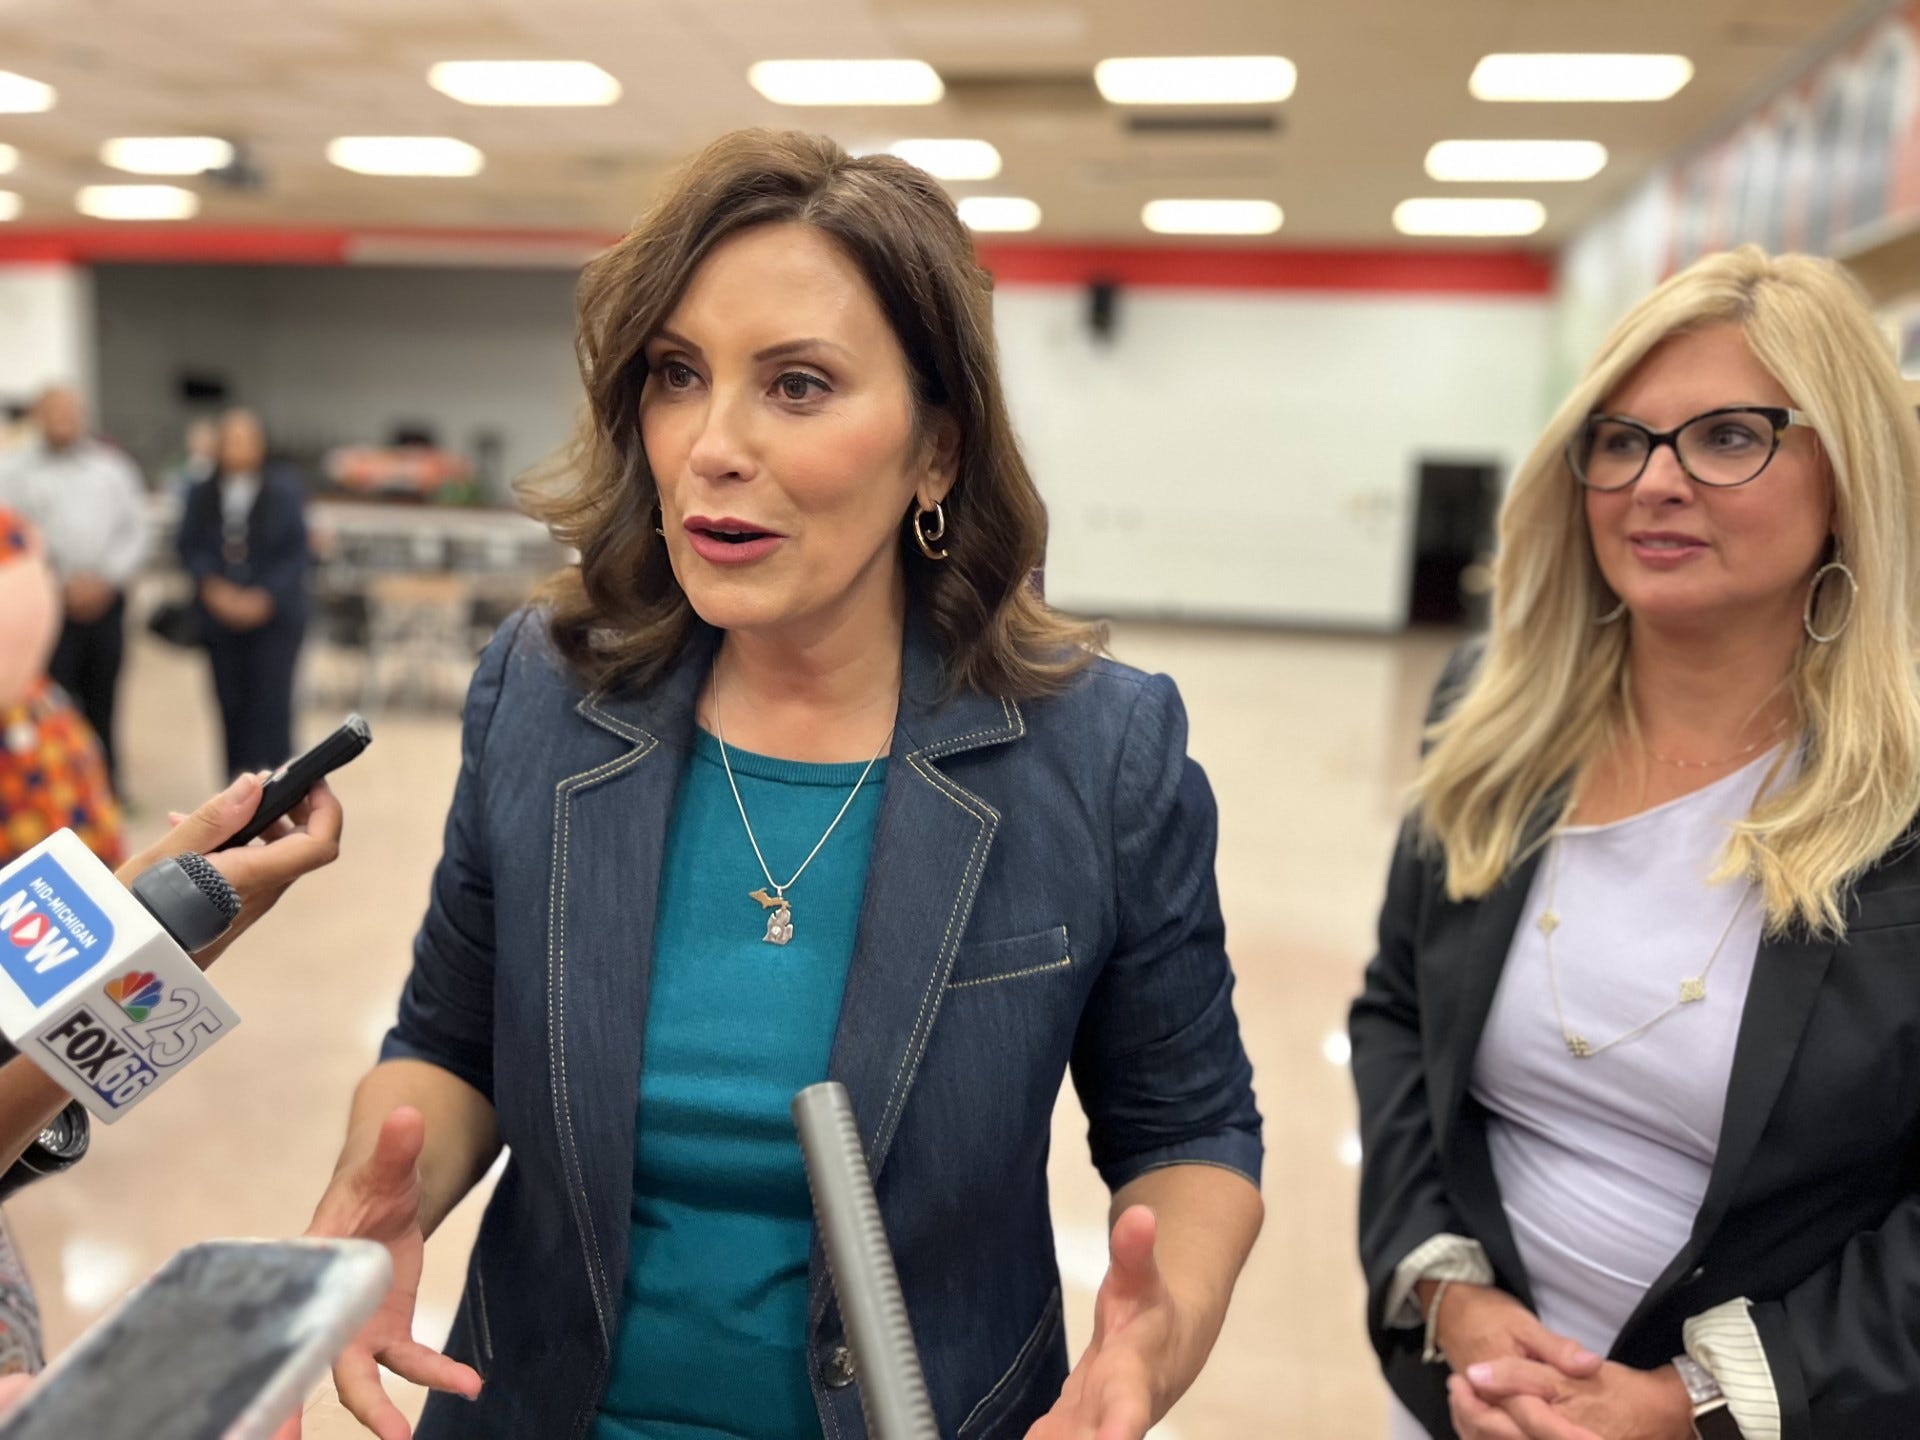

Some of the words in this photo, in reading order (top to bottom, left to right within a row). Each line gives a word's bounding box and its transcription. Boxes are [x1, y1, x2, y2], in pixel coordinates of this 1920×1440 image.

[0, 889, 79, 974] NOW
[29, 876, 98, 949] MID-MICHIGAN
[121, 987, 223, 1067] 25
